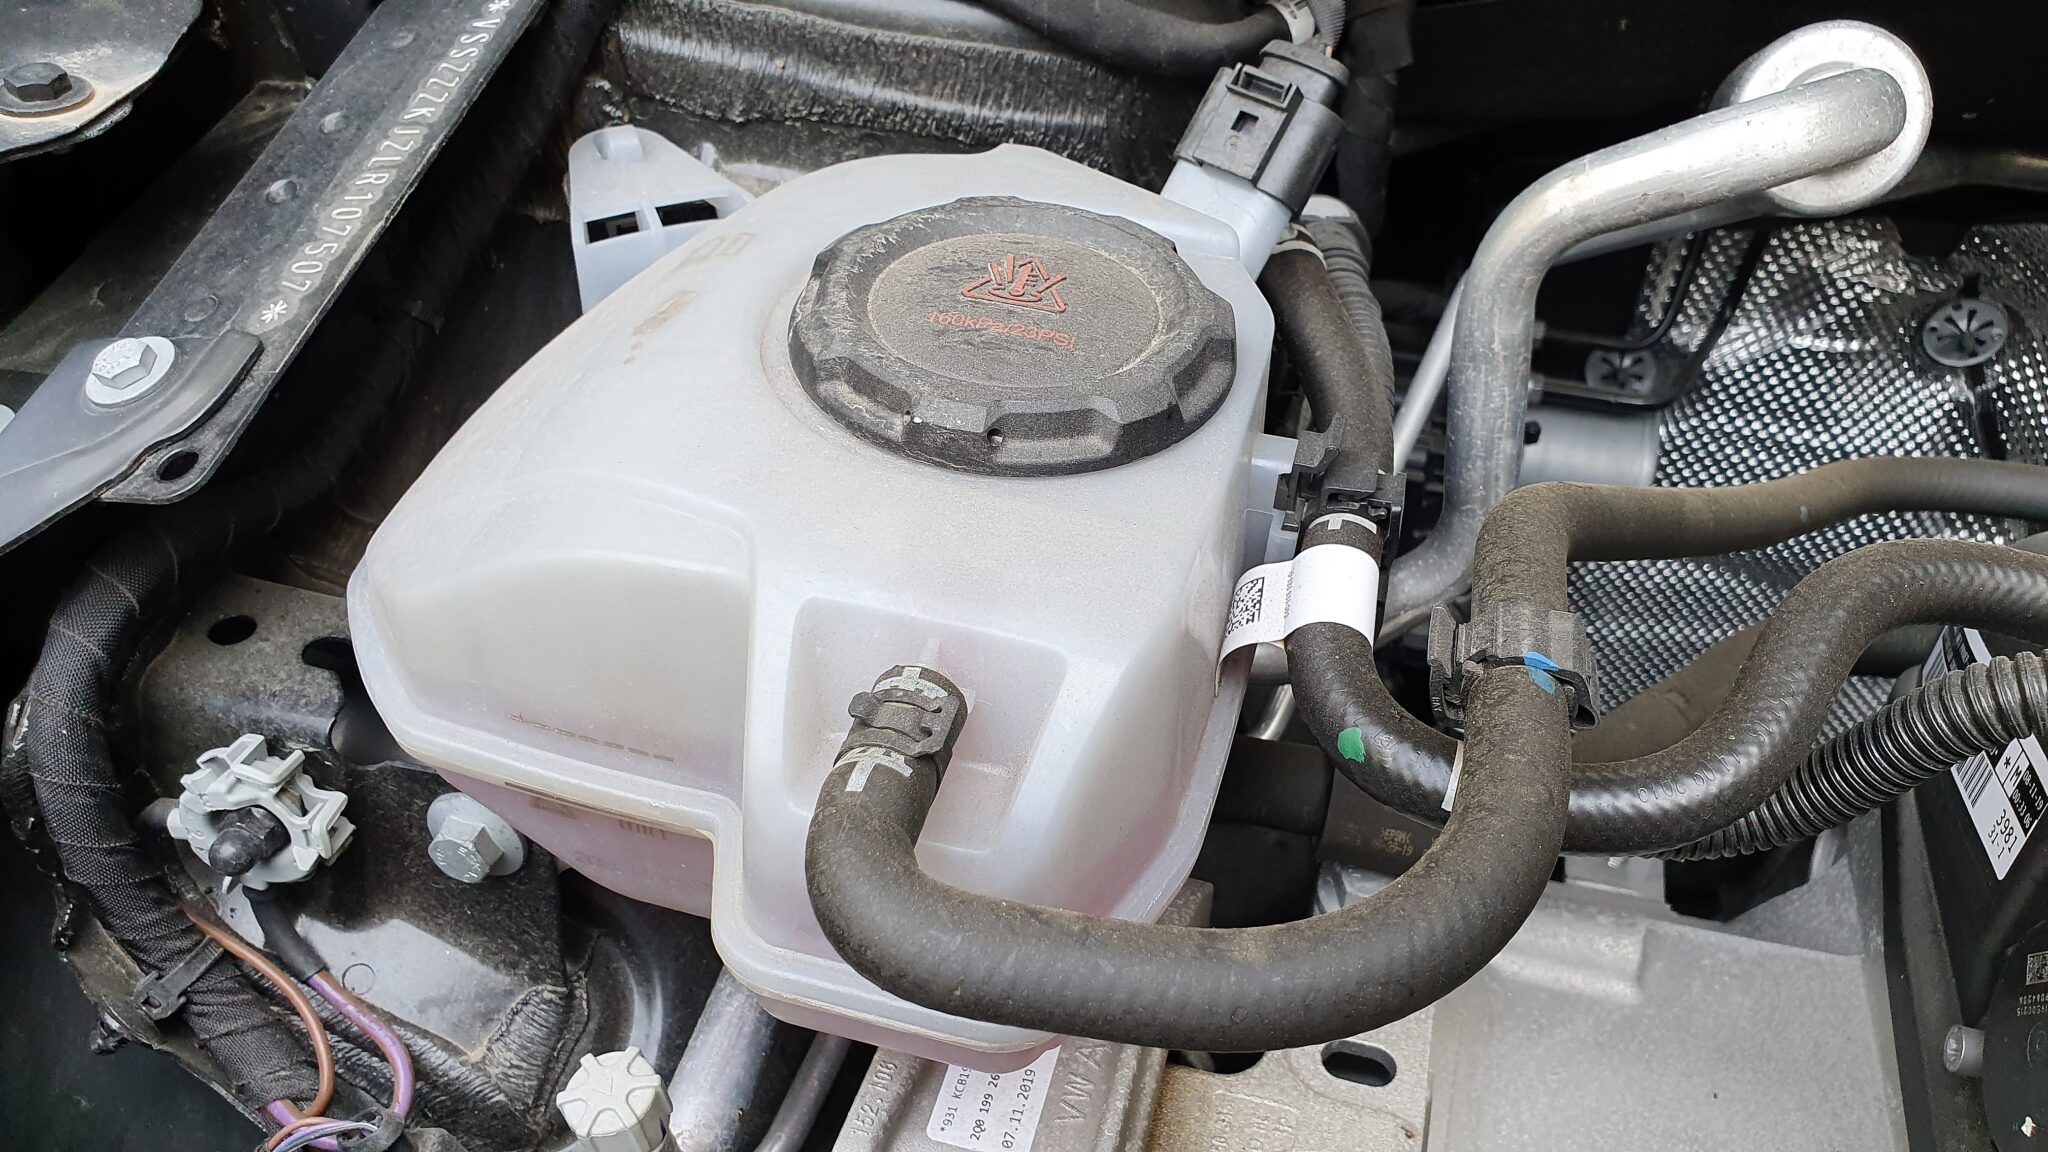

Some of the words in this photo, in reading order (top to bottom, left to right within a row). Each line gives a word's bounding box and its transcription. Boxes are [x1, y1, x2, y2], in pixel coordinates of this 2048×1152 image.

[1996, 808, 2018, 854] 3981
[980, 1093, 994, 1114] 199
[987, 1073, 1001, 1088] 26
[1001, 1068, 1036, 1149] 07.11.2019
